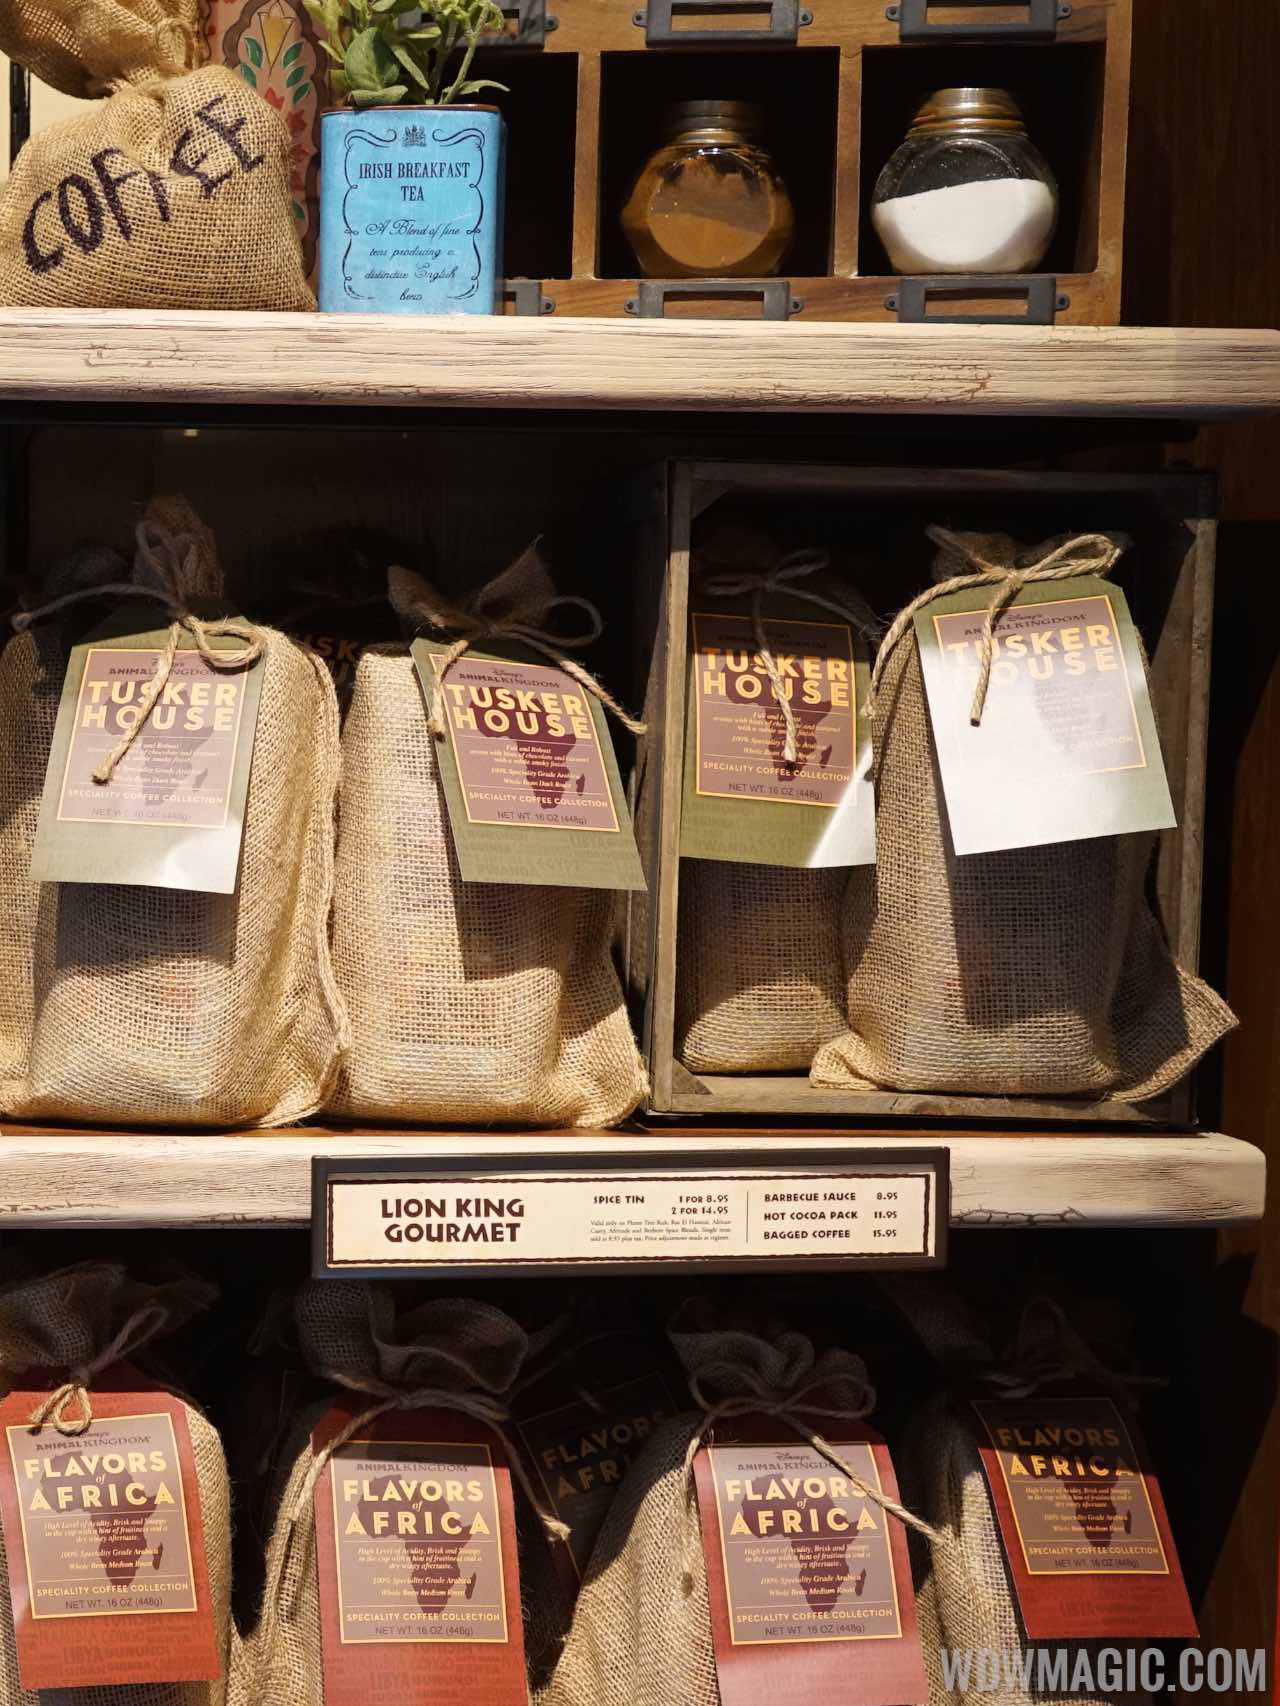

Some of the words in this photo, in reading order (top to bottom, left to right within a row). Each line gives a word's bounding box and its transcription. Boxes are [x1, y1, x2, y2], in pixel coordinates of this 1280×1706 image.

[359, 163, 392, 179] IRISH
[398, 162, 471, 179] BREAKFAST
[21, 96, 266, 276] COFFEE
[401, 185, 425, 201] TEA
[389, 218, 430, 236] Blend
[428, 223, 440, 240] of
[439, 222, 460, 242] fine
[391, 246, 442, 262] producing
[414, 263, 459, 283] English
[946, 624, 1113, 661] TUSKER
[703, 647, 848, 682] TUSKER
[87, 680, 238, 707] TUSKER
[703, 670, 849, 707] HOUSE
[445, 684, 584, 717] TUSKER
[81, 704, 234, 732] HOUSE
[452, 706, 593, 739] HOUSE
[703, 761, 753, 774] SPECIALITY
[756, 766, 791, 777] COFFEE
[793, 769, 850, 782] COLLECTION
[469, 791, 517, 801] SPECIALITY
[519, 795, 552, 804] COFFEE
[554, 798, 608, 808] COLLECTION
[728, 783, 747, 792] NET
[768, 786, 779, 794] 16
[781, 787, 794, 796] OZ
[797, 788, 823, 800] (448g)
[593, 1195, 620, 1204] SPICE
[626, 1195, 645, 1204] TIN
[685, 1195, 703, 1203] FOR
[706, 1195, 729, 1203] 8.95
[764, 1193, 819, 1202] BARBECUE
[823, 1192, 856, 1201] SAUCE
[876, 1192, 898, 1200] 8.95
[381, 1198, 447, 1219] LION
[455, 1198, 525, 1218] KING
[671, 1206, 676, 1215] 2
[680, 1206, 698, 1214] FOR
[701, 1206, 729, 1215] 14.95
[764, 1212, 786, 1221] HOT
[790, 1211, 826, 1220] COCOA
[830, 1211, 858, 1220] PACK
[874, 1211, 897, 1219] 11.95
[384, 1222, 521, 1243] GOURMET
[763, 1230, 808, 1240] BAGGED
[812, 1230, 851, 1239] COFFEE
[873, 1229, 897, 1238] 15.95
[997, 1427, 1121, 1449] FLAVORS
[23, 1451, 168, 1480] FLAVORS
[1010, 1455, 1134, 1477] AFRICA
[95, 1473, 106, 1486] of
[725, 1477, 871, 1502] FLAVORS
[30, 1482, 175, 1512] AFRICA
[342, 1479, 484, 1502] FLAVORS
[412, 1499, 423, 1513] of
[796, 1498, 807, 1510] of
[344, 1511, 491, 1536] AFRICA
[730, 1507, 878, 1536] AFRICA
[1028, 1547, 1074, 1555] SPECIALITY
[1109, 1546, 1159, 1554] COLLECTION
[36, 1587, 89, 1598] SPECIALITY
[93, 1585, 129, 1595] COFFEE
[131, 1582, 188, 1593] COLLECTION
[65, 1600, 85, 1609] NET
[107, 1599, 118, 1607] 16
[120, 1598, 133, 1607] OZ
[135, 1597, 163, 1608] (448g)
[347, 1613, 400, 1622] SPECIALITY
[403, 1612, 440, 1621] COFFEE
[442, 1612, 500, 1621] COLLECTION
[736, 1613, 789, 1623] SPECIALITY
[792, 1611, 829, 1621] COFFEE
[831, 1608, 893, 1619] COLLECTION
[765, 1627, 784, 1636] NET
[807, 1625, 818, 1634] 16
[820, 1624, 833, 1634] OZ
[836, 1623, 866, 1635] (448g)
